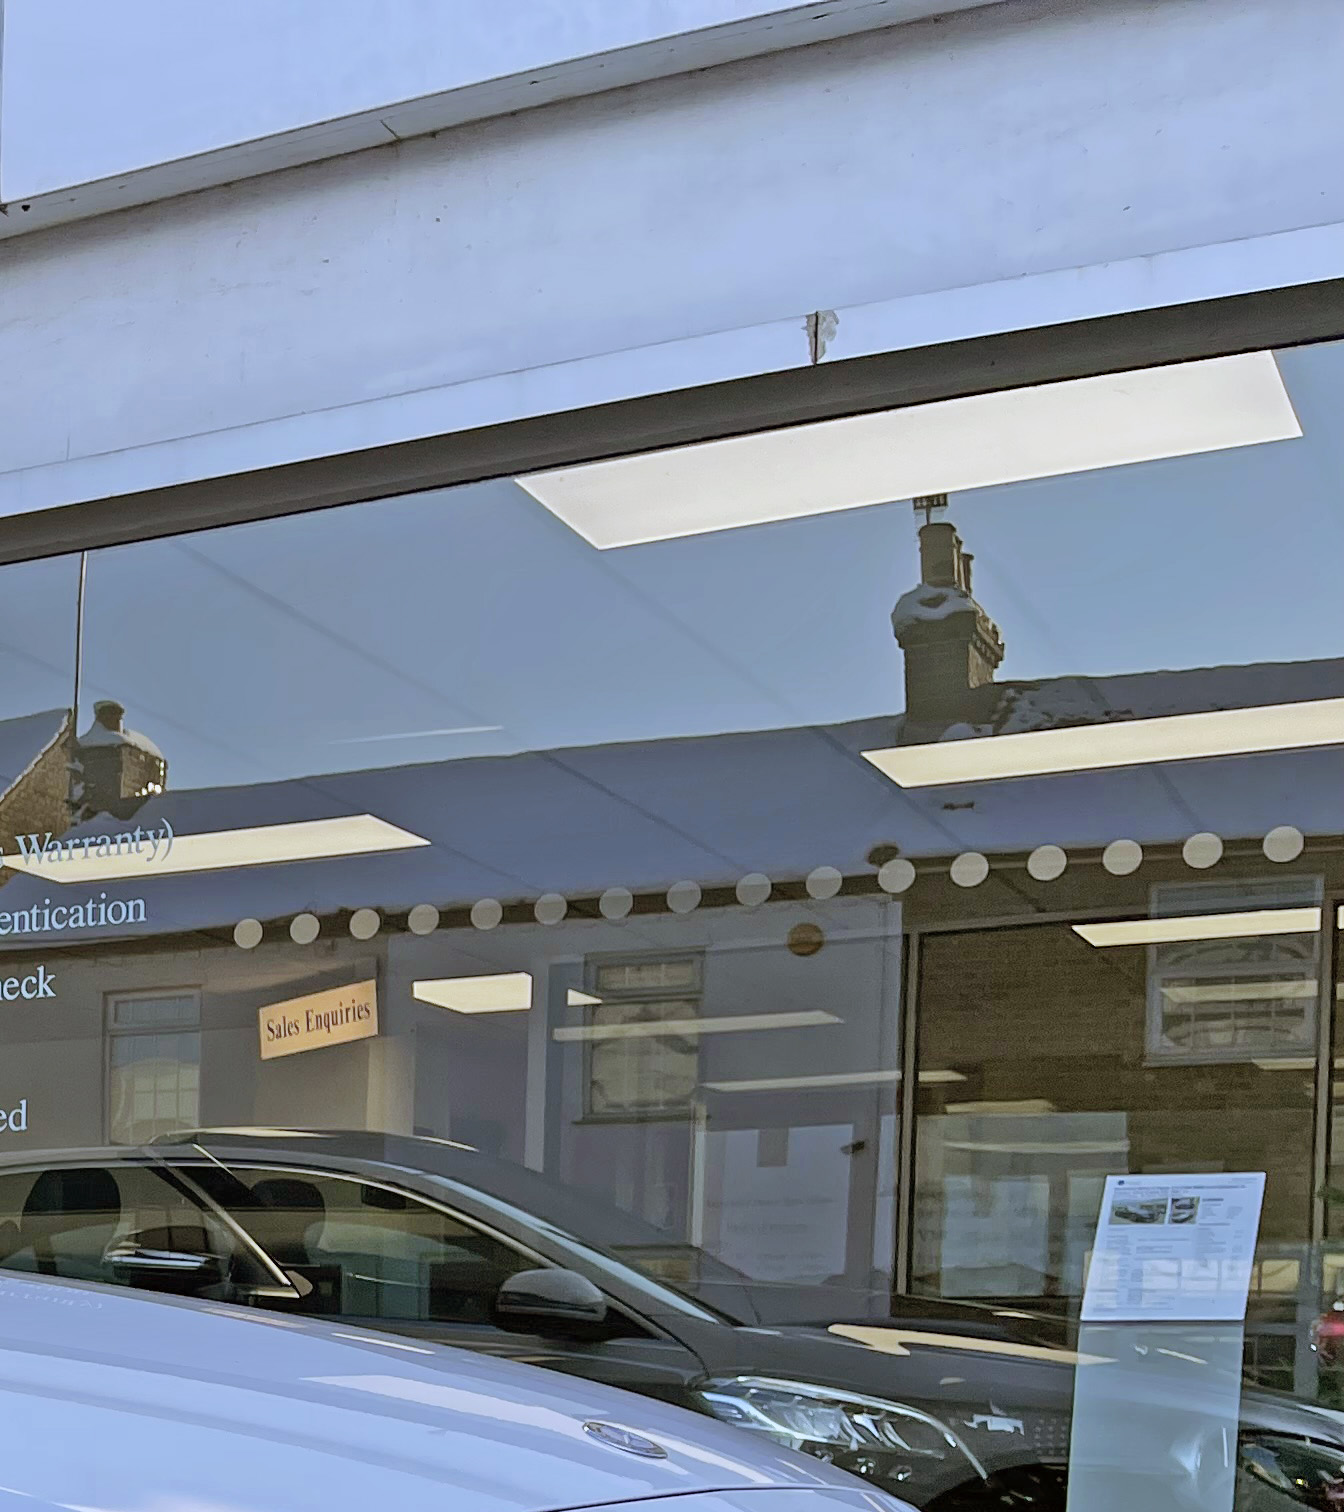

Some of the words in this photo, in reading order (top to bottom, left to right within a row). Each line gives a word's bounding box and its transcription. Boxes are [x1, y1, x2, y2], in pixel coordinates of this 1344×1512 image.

[16, 818, 173, 866] Warranty)
[266, 1016, 300, 1042] Sales
[305, 998, 371, 1034] Enquiries
